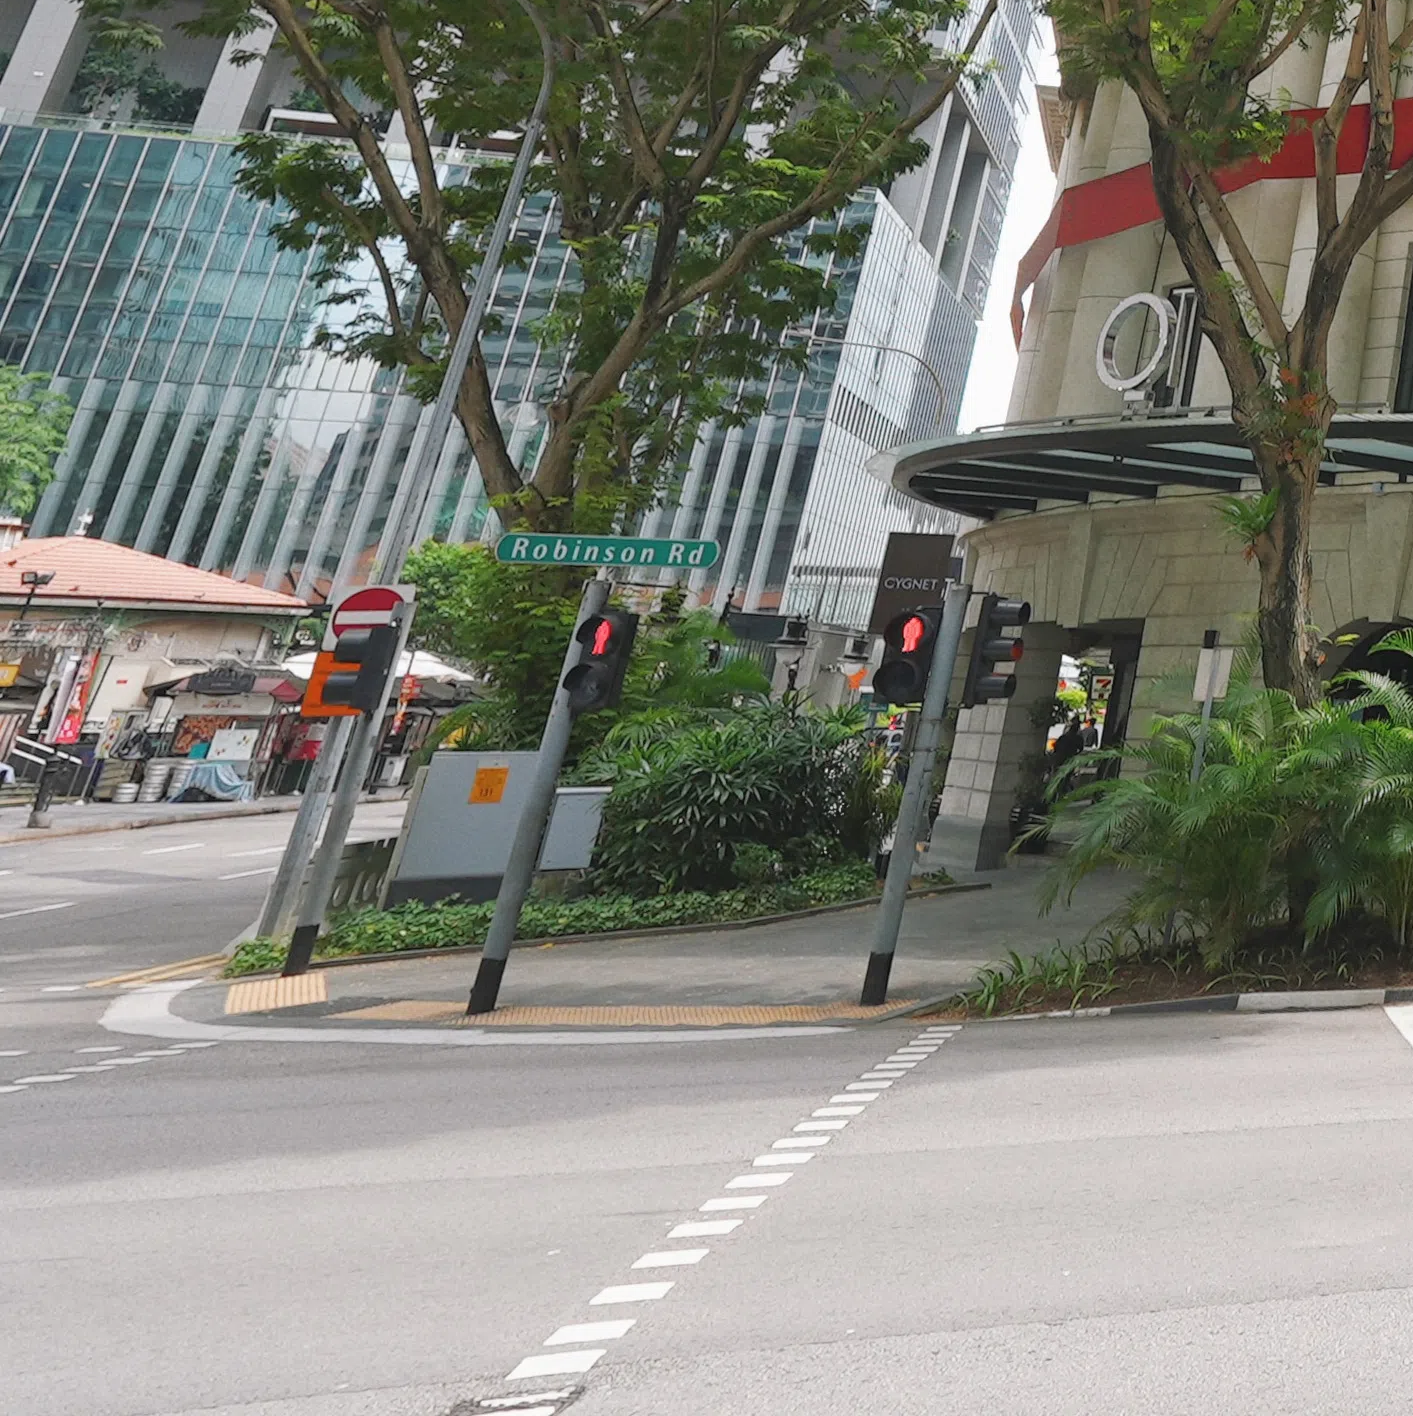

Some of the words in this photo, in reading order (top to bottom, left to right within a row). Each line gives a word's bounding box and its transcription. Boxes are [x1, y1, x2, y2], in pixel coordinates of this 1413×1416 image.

[511, 537, 654, 563] Robinson
[668, 543, 704, 565] Rd
[883, 577, 938, 590] CYGNET
